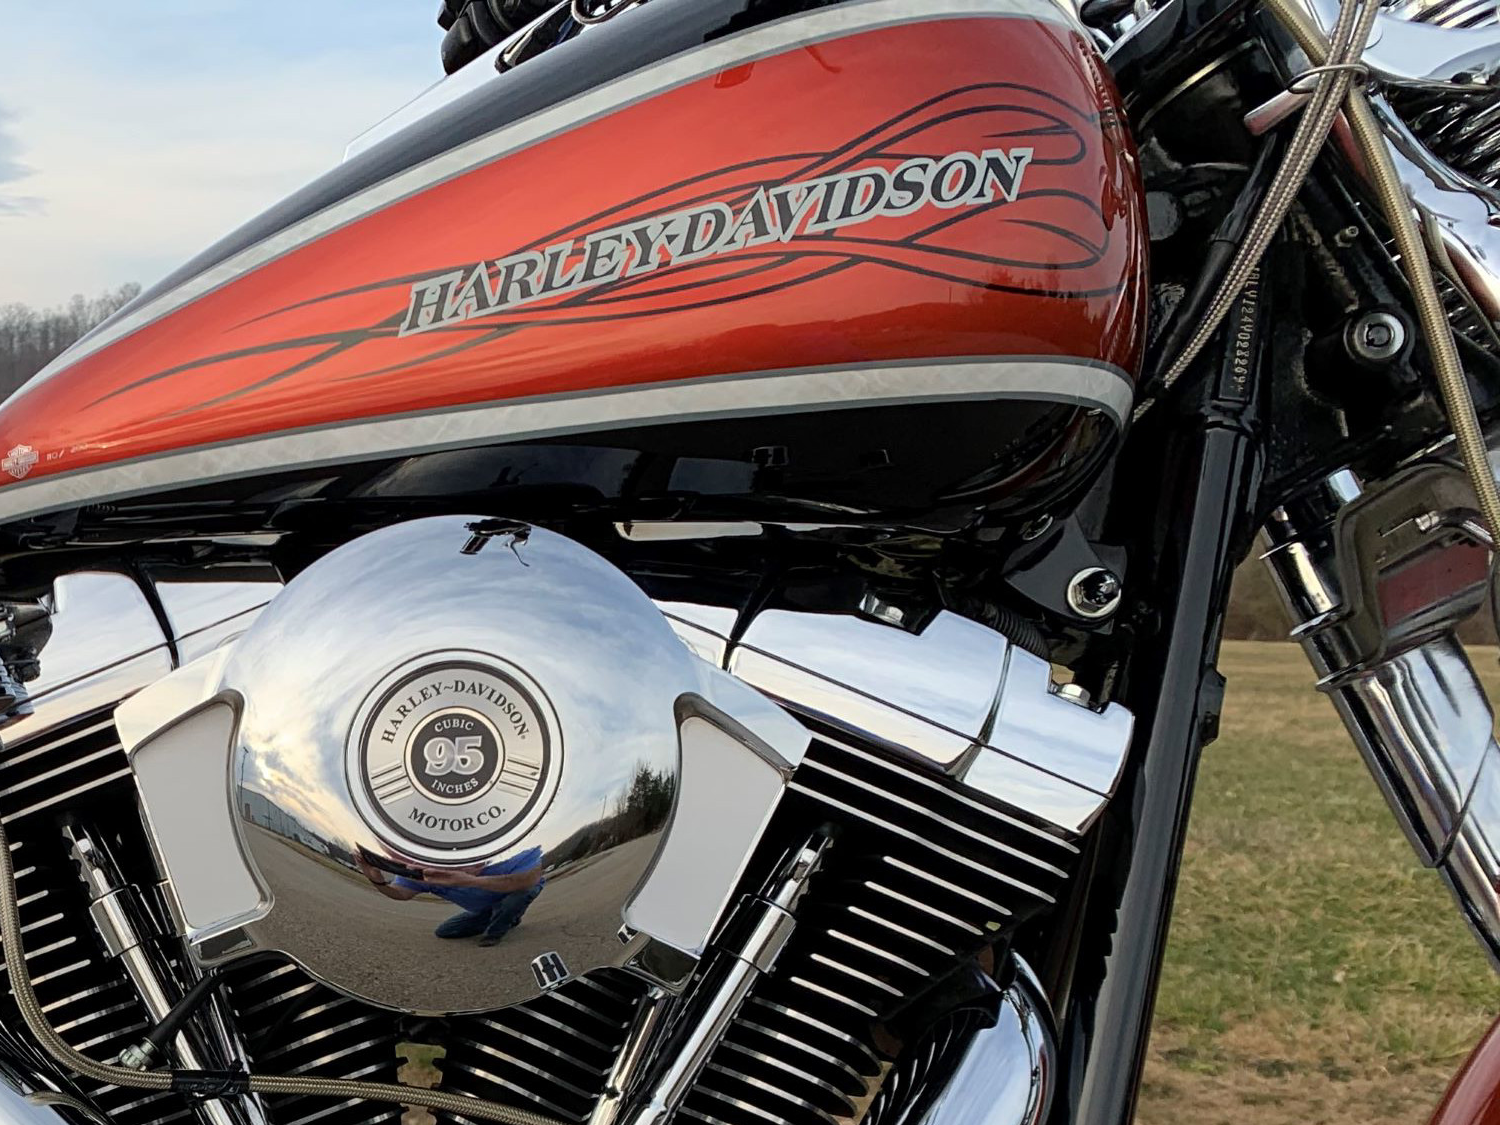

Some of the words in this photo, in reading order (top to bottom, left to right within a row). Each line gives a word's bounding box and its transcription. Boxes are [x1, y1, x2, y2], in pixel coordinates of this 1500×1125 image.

[434, 718, 475, 733] CUBIC
[423, 735, 485, 776] 95
[431, 777, 479, 794] INCHES
[408, 807, 475, 832] MOTOR
